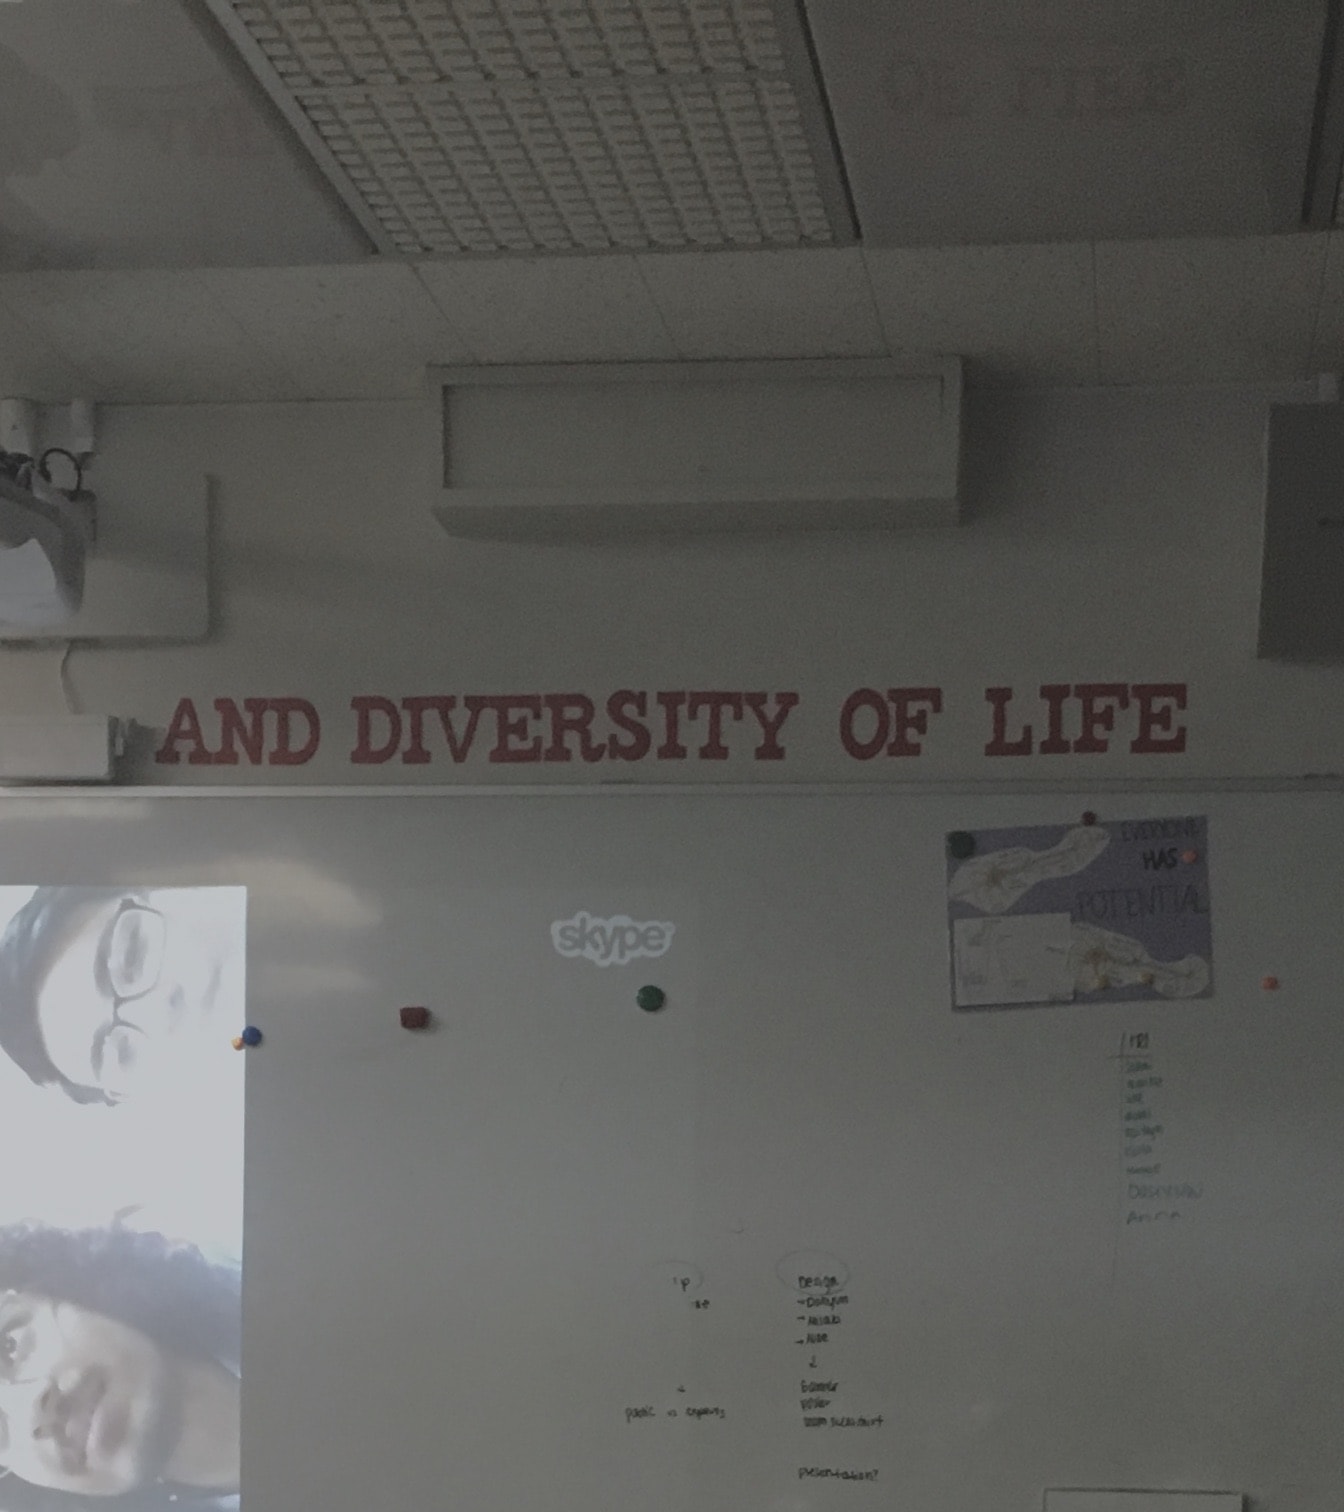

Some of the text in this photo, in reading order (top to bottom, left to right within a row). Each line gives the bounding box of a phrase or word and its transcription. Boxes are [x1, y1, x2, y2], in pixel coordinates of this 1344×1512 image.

[155, 697, 319, 766] AND
[349, 689, 800, 765] DIVERSITY
[839, 687, 943, 758] OF
[985, 684, 1189, 755] LIFE
[1142, 847, 1179, 870] HAS
[1074, 884, 1211, 920] POTENTIAL
[558, 916, 666, 960] skype
